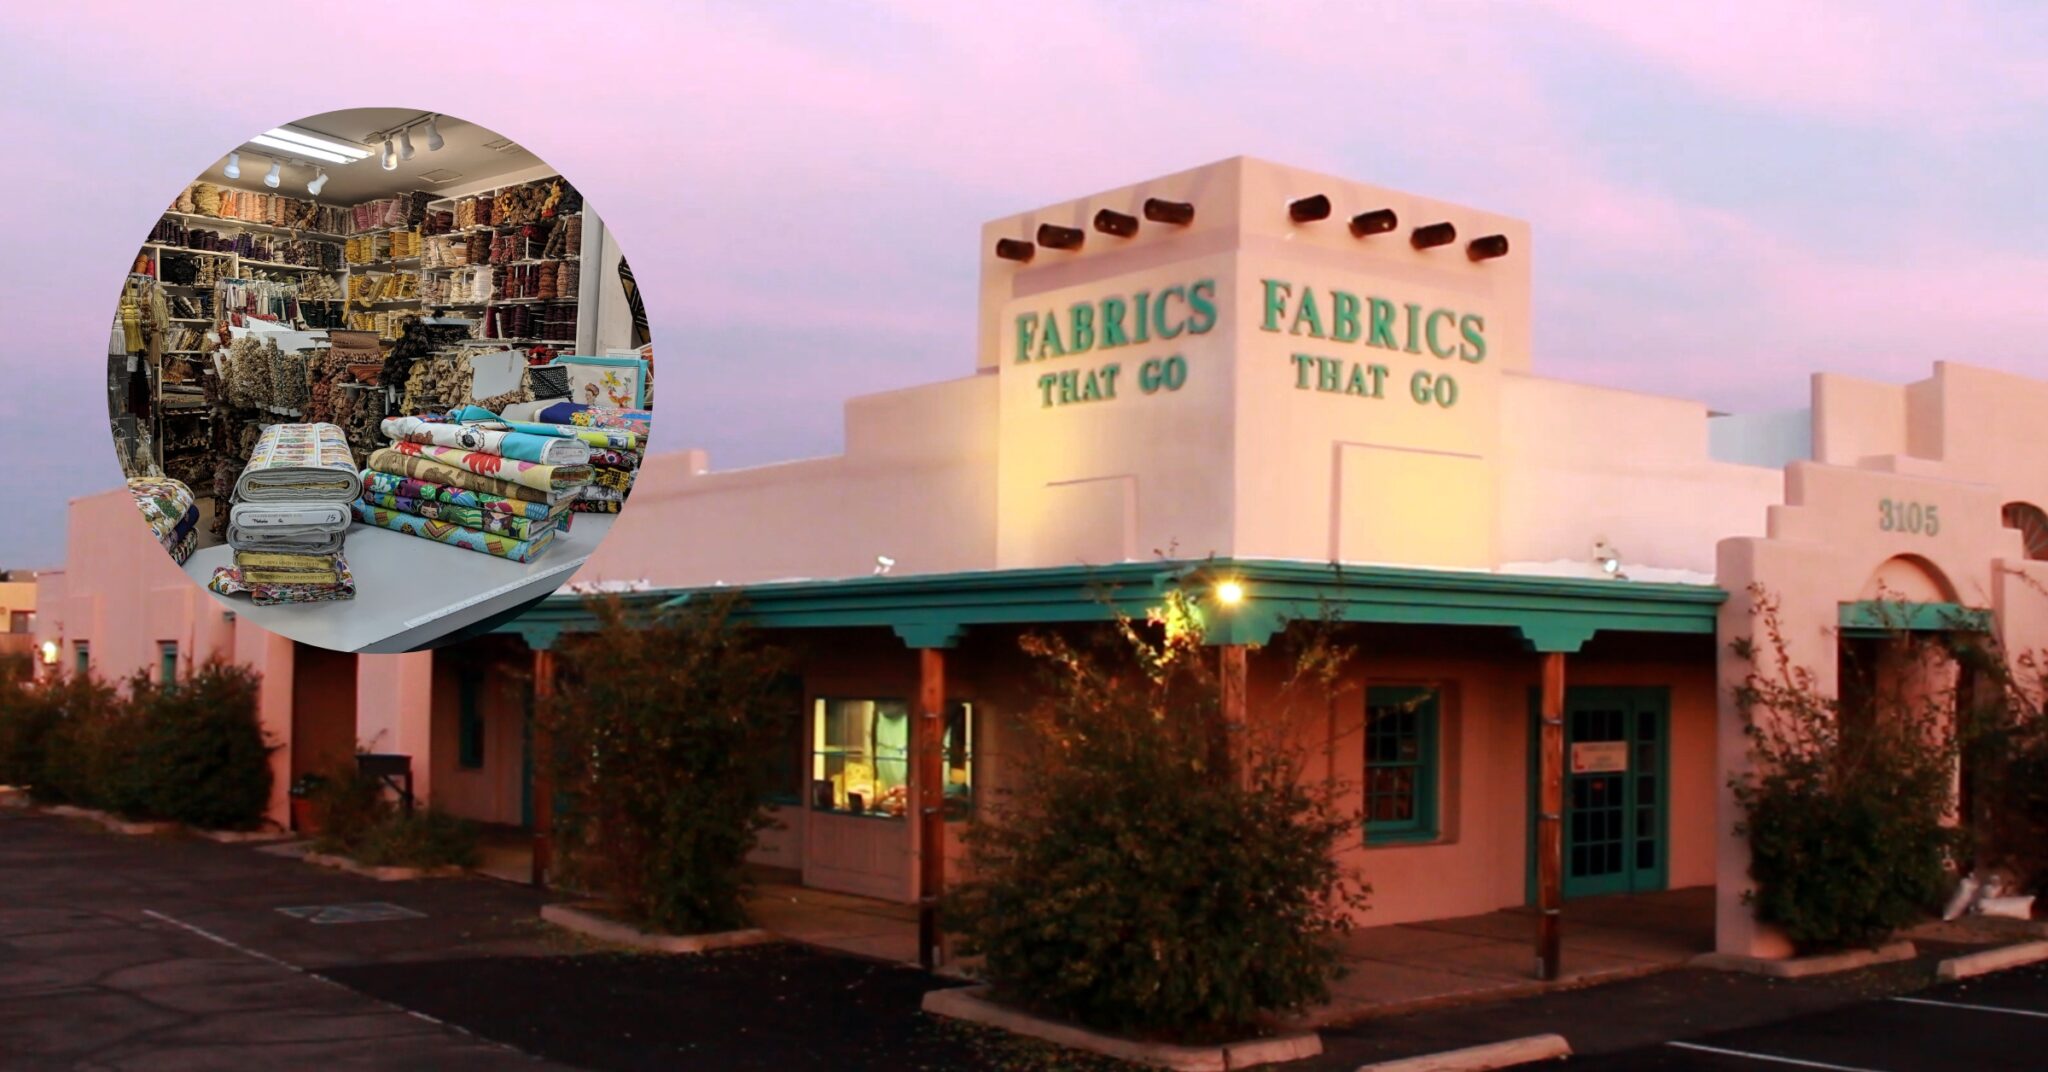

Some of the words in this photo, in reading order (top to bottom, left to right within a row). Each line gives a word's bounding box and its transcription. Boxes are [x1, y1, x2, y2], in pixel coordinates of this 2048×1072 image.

[1014, 279, 1217, 364] FABRICS
[1259, 278, 1487, 364] FABRICS
[1038, 363, 1120, 408] THAT
[1138, 353, 1187, 395] GO
[1290, 353, 1389, 399] THAT
[1410, 369, 1459, 408] GO
[1879, 498, 1940, 538] 3105
